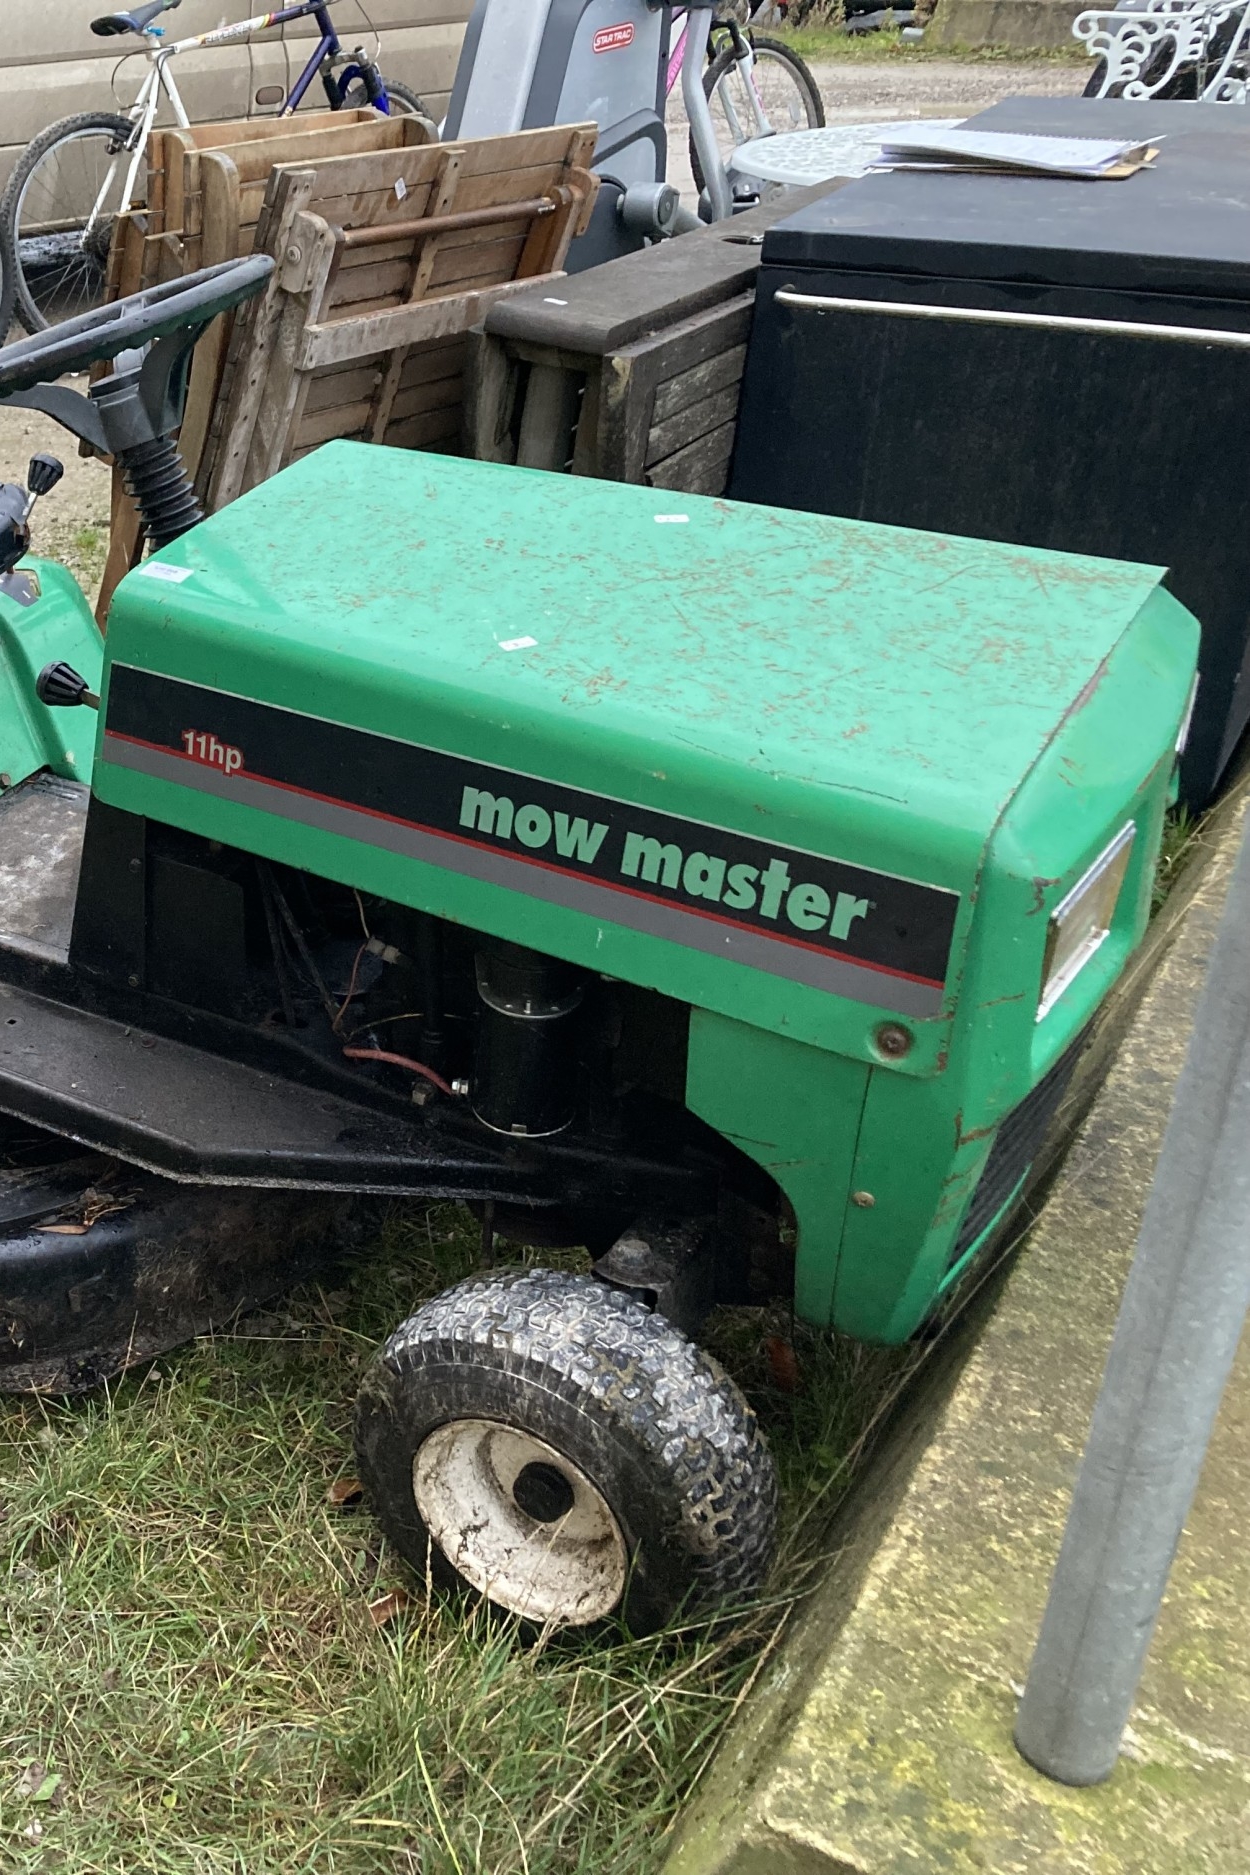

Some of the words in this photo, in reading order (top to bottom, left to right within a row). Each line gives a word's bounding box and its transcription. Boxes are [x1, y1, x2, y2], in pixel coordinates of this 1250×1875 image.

[596, 34, 614, 46] STAR
[614, 28, 632, 42] TRAC
[184, 731, 242, 774] 11hp
[459, 785, 610, 865] mow
[620, 831, 869, 941] master
